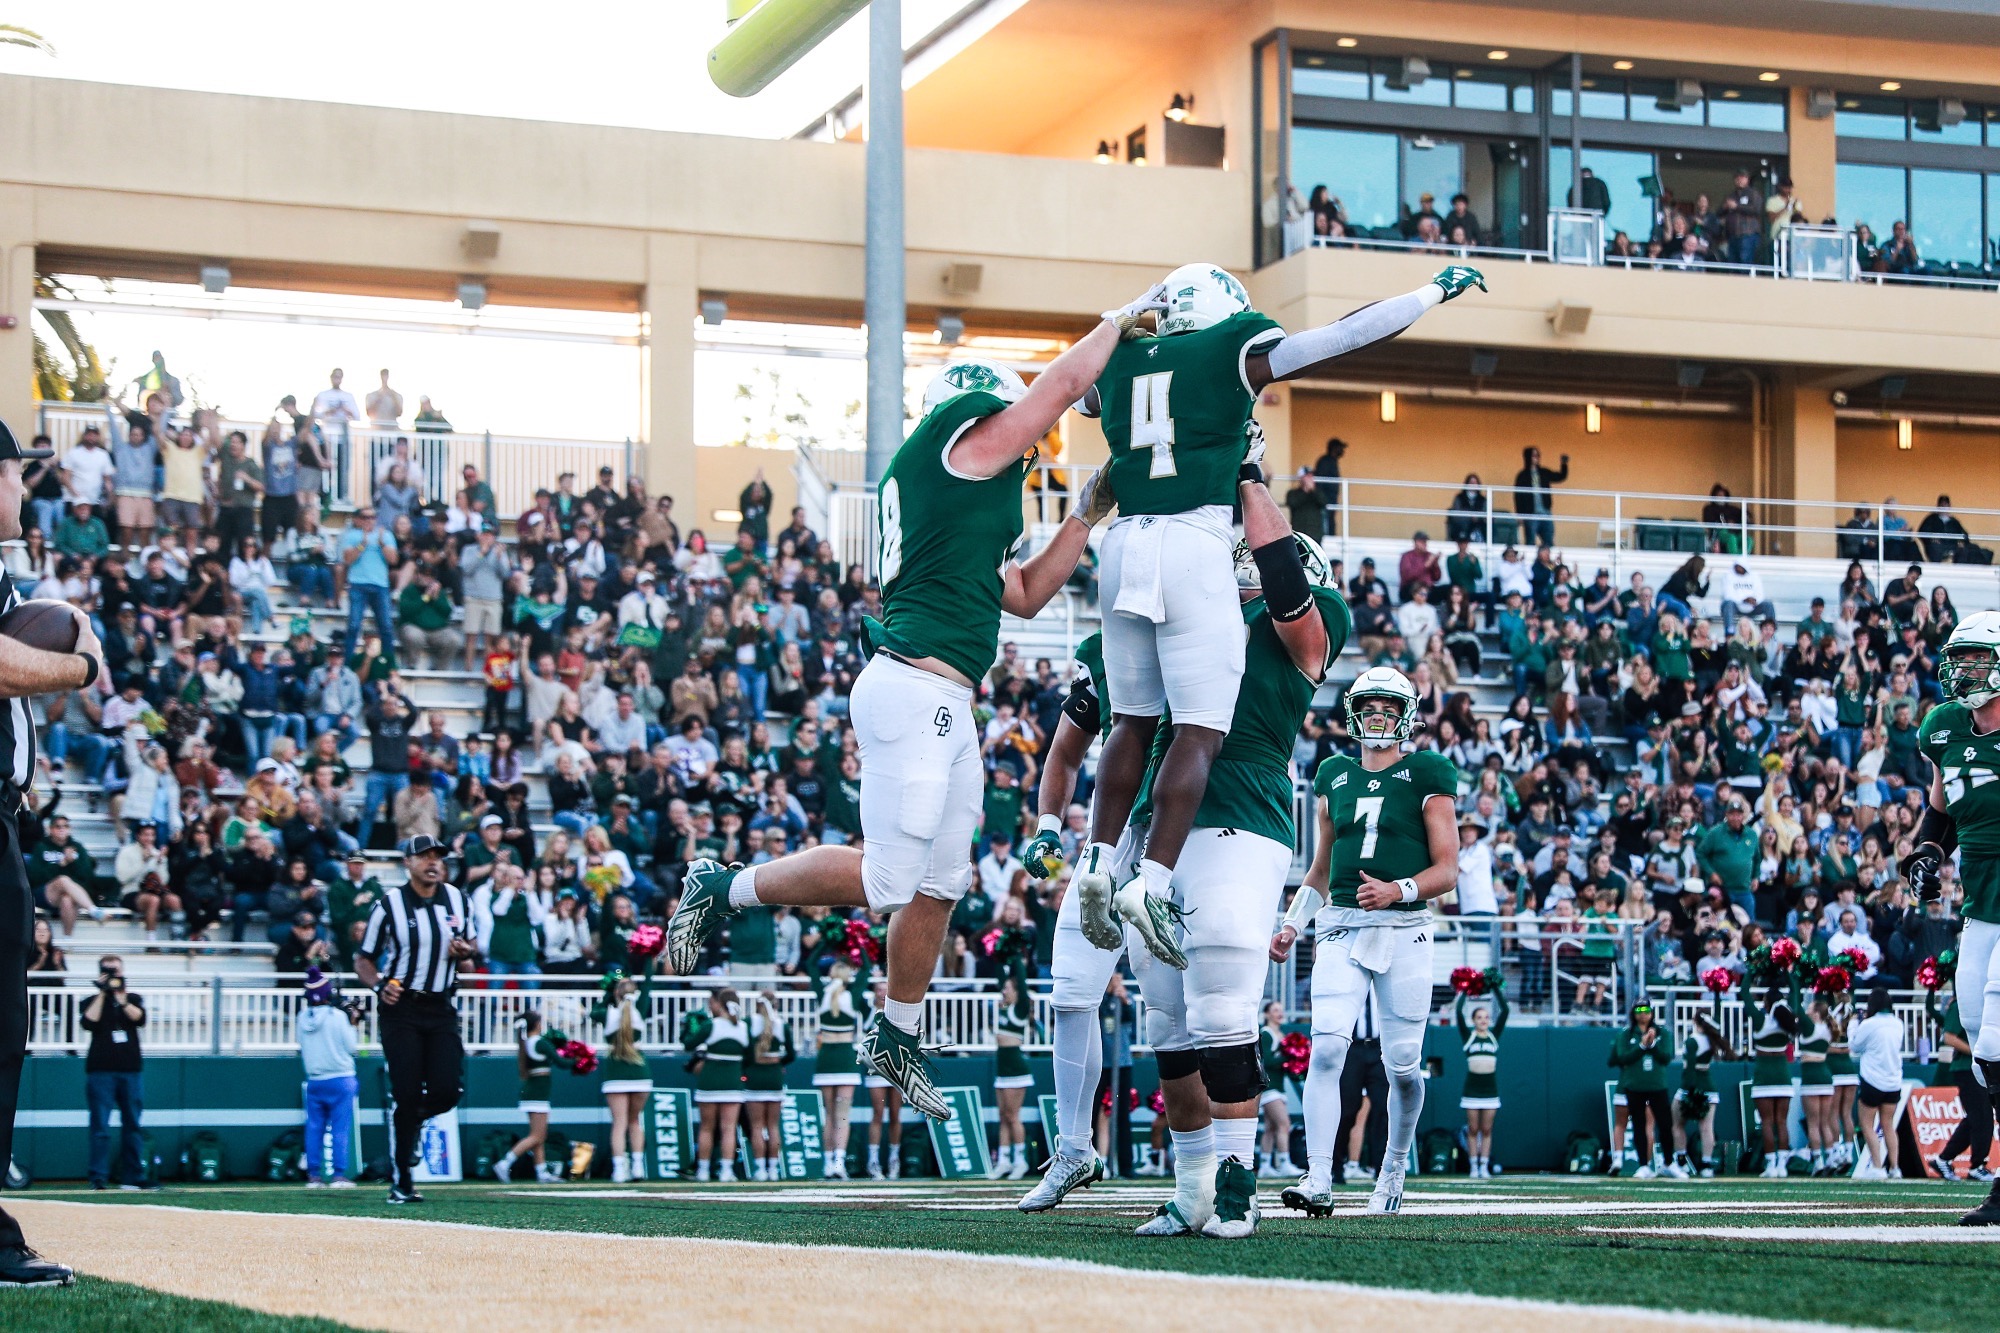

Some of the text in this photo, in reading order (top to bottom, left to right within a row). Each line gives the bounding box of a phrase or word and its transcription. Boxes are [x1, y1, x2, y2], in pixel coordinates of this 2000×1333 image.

[1130, 371, 1178, 480] 4
[1353, 796, 1385, 859] 7
[1911, 1095, 1967, 1119] Kind
[654, 1092, 681, 1179] GREEN
[799, 1111, 823, 1160] FEET
[787, 1150, 807, 1178] ON
